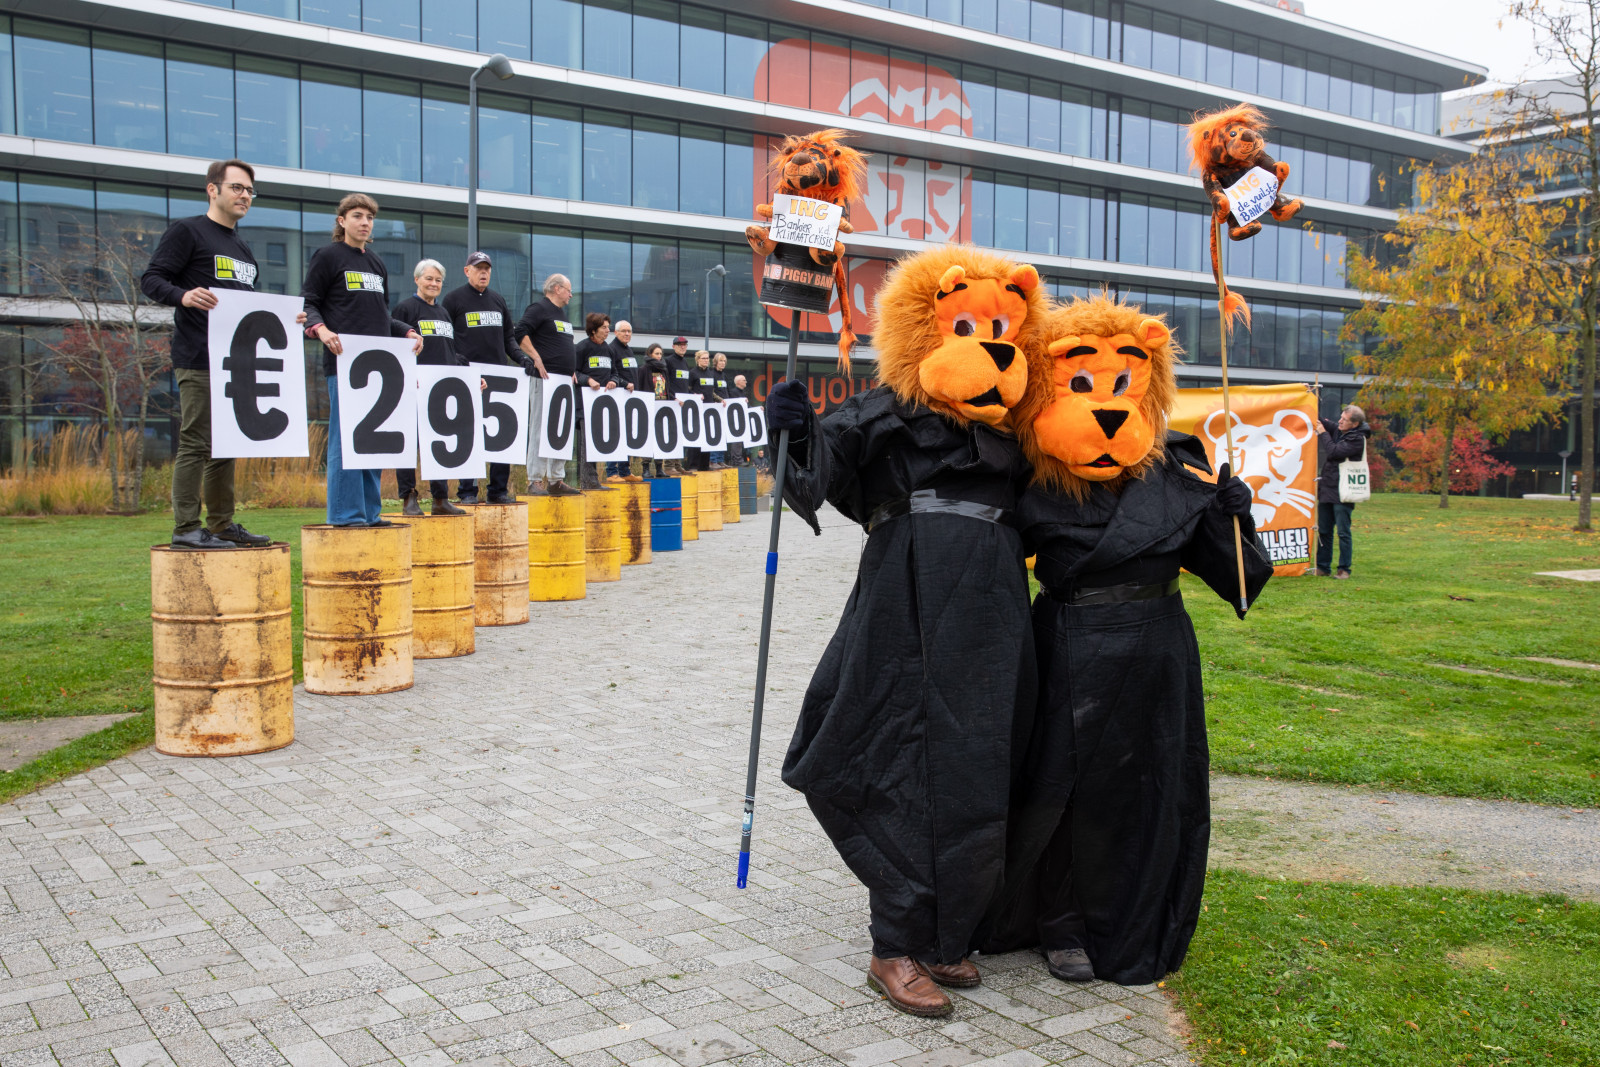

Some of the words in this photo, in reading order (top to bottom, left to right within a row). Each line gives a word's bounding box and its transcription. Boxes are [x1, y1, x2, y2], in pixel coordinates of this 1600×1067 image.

[1229, 173, 1260, 200] ING
[1237, 201, 1250, 212] de
[1250, 182, 1278, 204] vuilste
[790, 199, 829, 220] ING
[1240, 202, 1264, 222] BANK
[782, 267, 813, 284] PIGGY
[222, 310, 289, 441] €
[349, 349, 405, 454] 2
[427, 377, 475, 468] 9
[481, 374, 518, 452] 5
[547, 383, 573, 451] 0
[590, 394, 620, 454] 0
[624, 397, 649, 449] 0
[654, 406, 678, 453] 0
[681, 399, 700, 441] 0
[703, 408, 722, 446] 0
[726, 402, 746, 437] 0
[1348, 474, 1367, 485] NO
[1257, 528, 1308, 548] ILIEU
[1267, 544, 1309, 561] ENSIE
